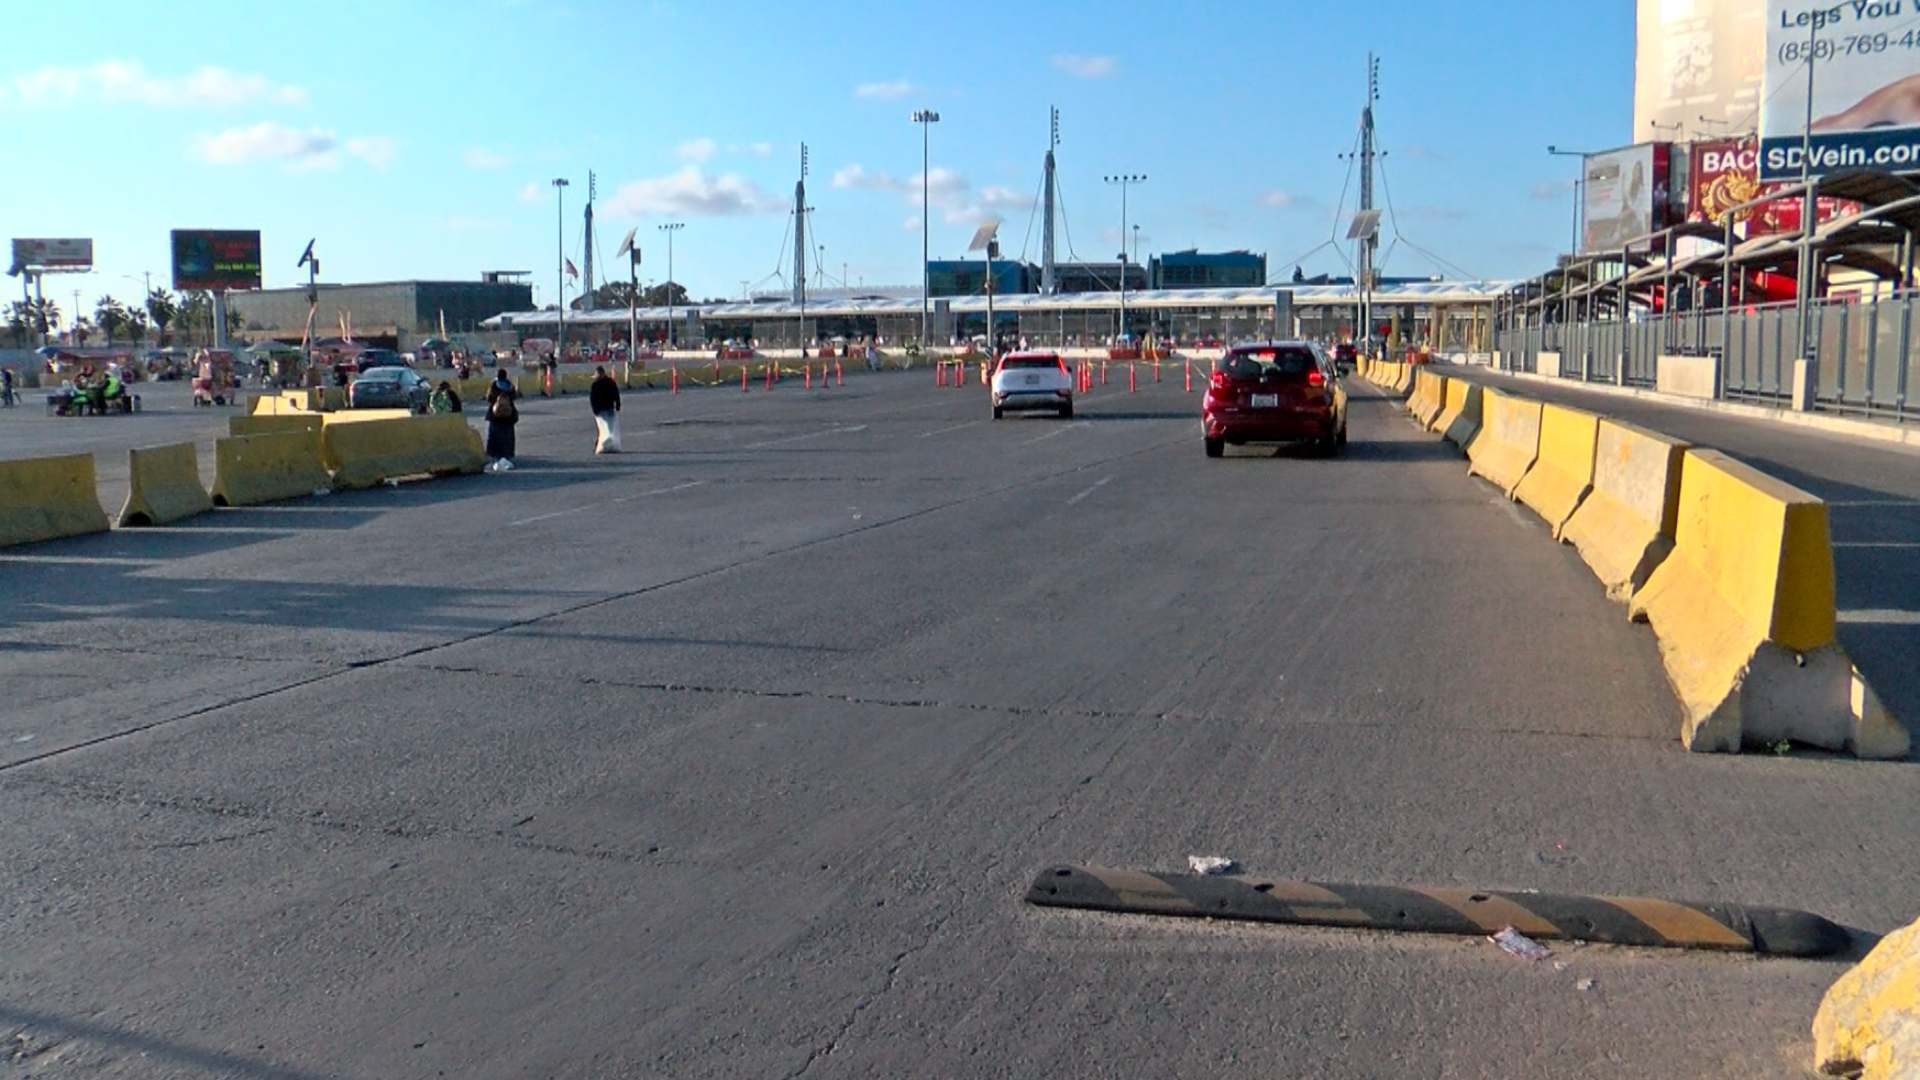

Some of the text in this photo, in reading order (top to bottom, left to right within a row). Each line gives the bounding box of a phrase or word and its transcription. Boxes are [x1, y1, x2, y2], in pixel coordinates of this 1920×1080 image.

[1781, 8, 1841, 29] Legs
[1852, 0, 1901, 20] You
[1703, 150, 1759, 172] BAC
